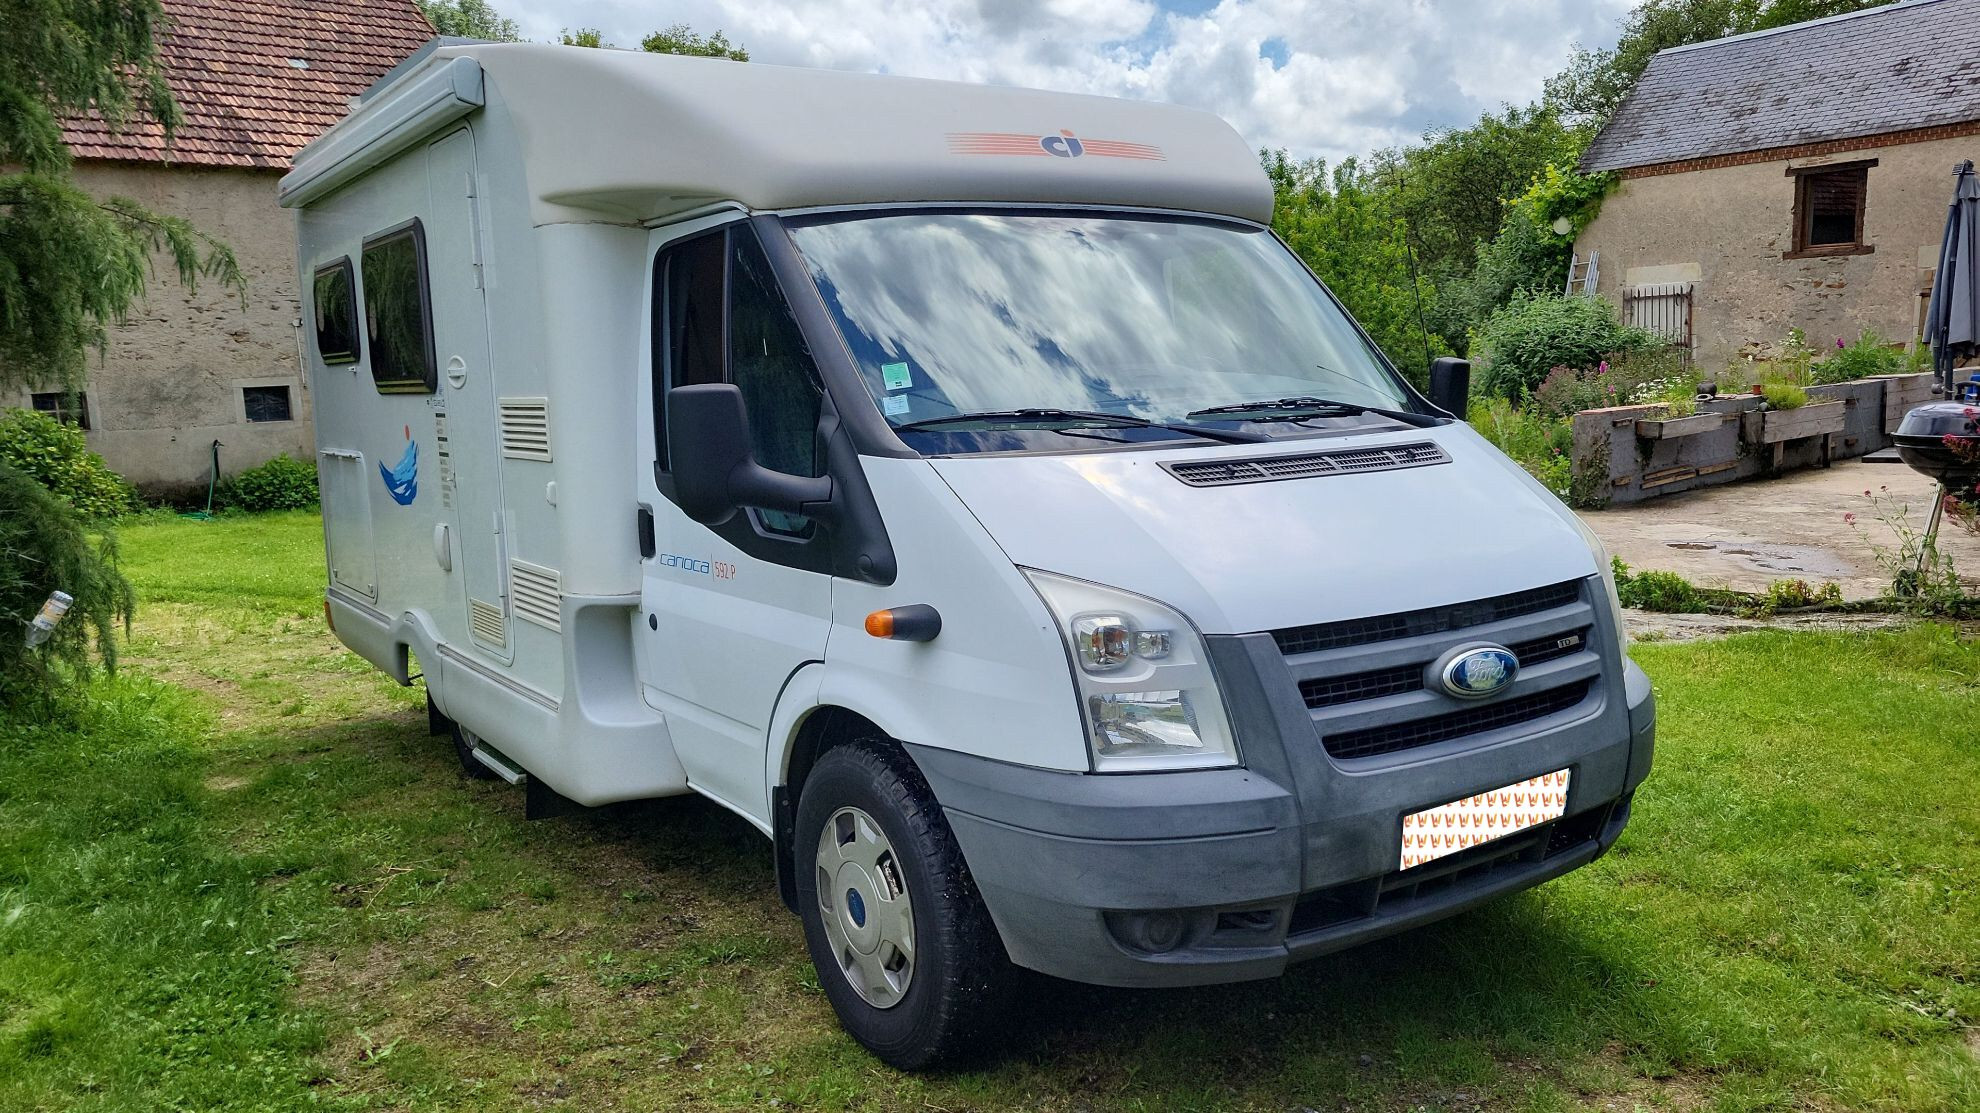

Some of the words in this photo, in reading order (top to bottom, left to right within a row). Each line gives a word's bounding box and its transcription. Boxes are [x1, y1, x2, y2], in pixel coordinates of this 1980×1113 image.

[714, 561, 728, 579] 592
[730, 564, 736, 580] P
[1467, 656, 1506, 682] Ford
